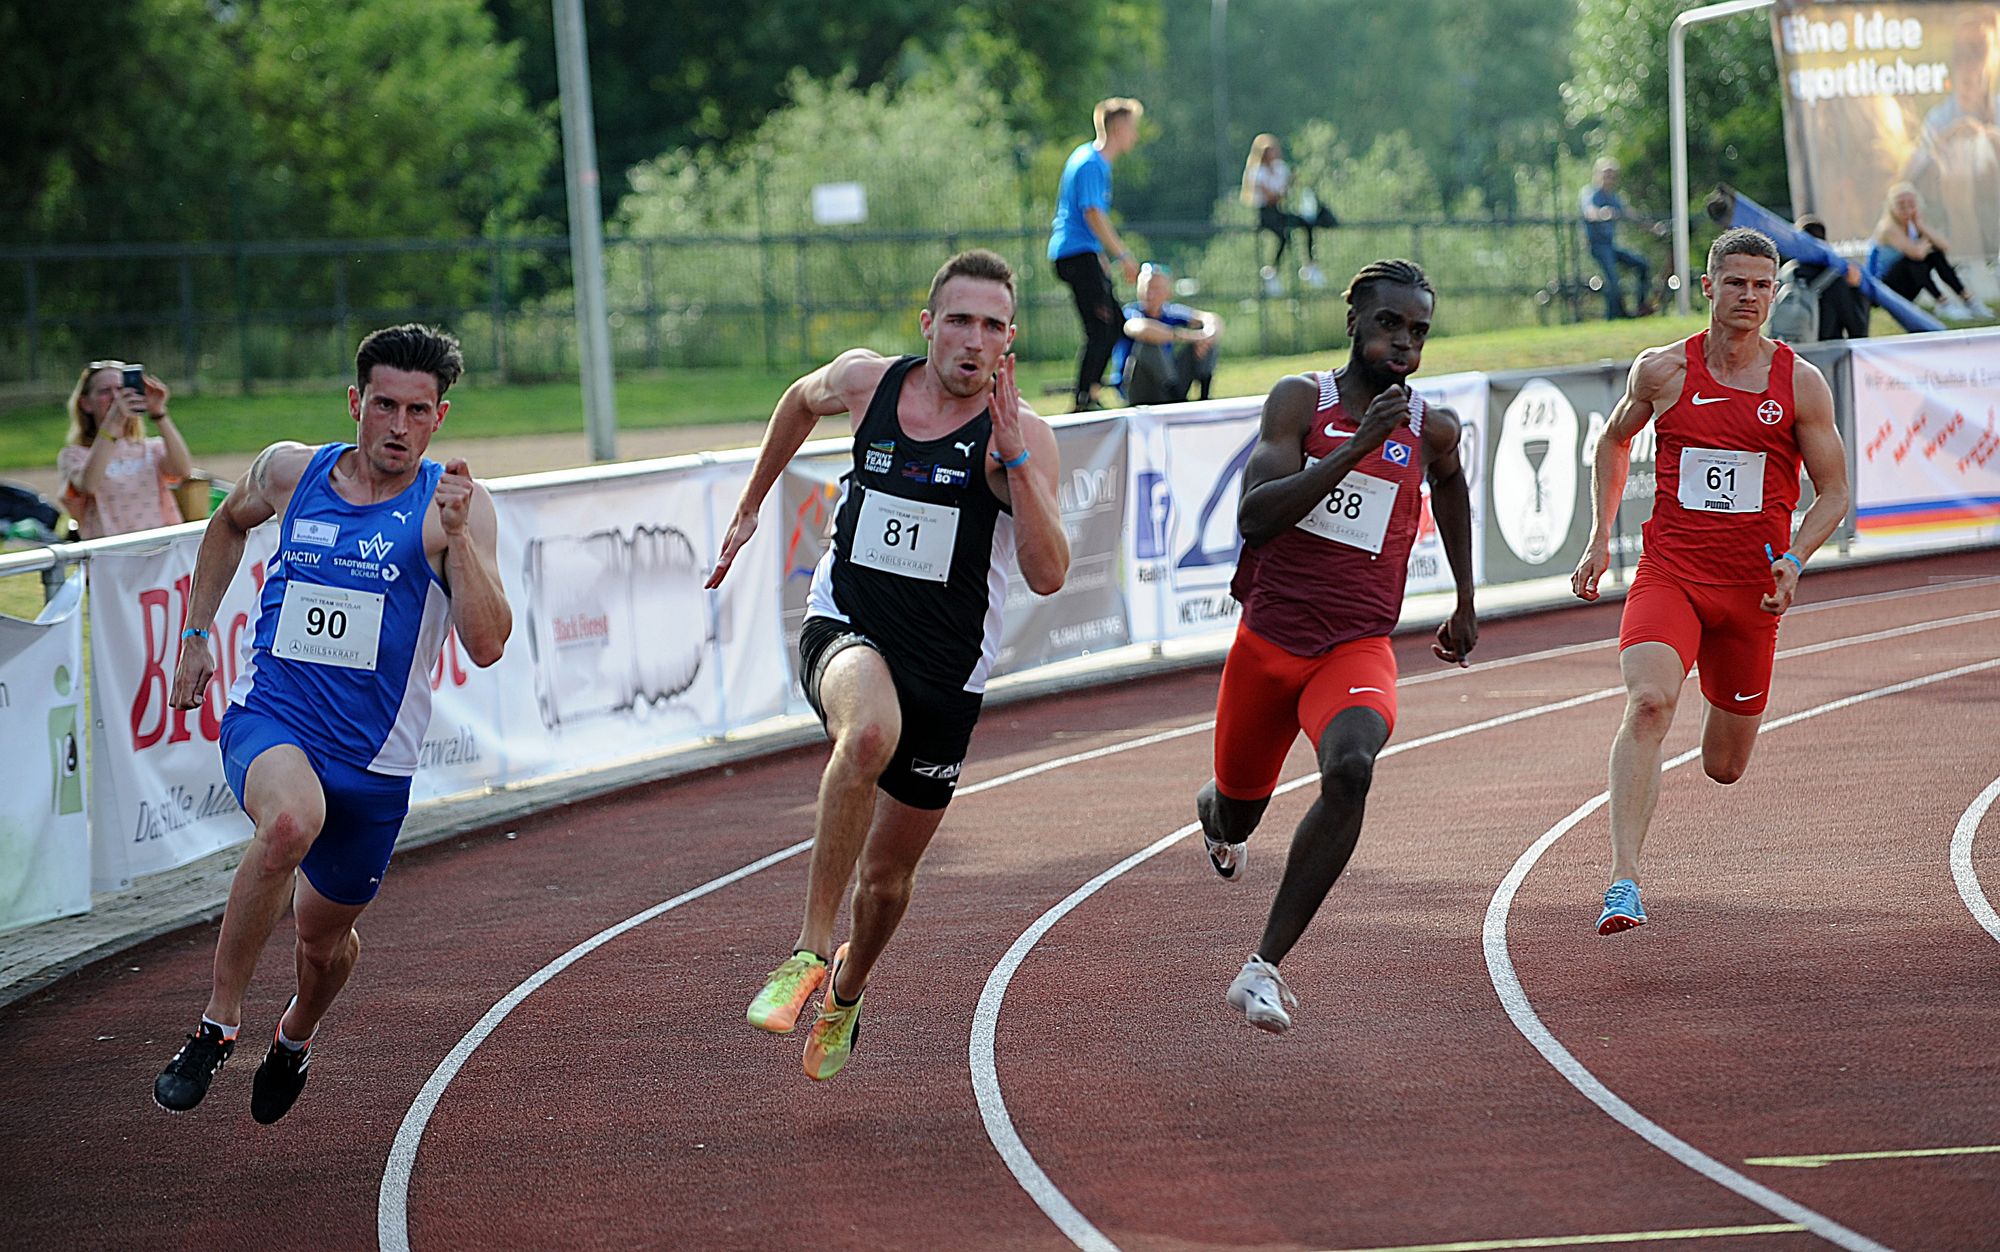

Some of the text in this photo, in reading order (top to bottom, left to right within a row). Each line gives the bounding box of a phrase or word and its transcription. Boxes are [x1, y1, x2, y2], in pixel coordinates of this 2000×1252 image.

[1854, 11, 1923, 50] Idee
[866, 449, 893, 461] SPRINT
[866, 456, 892, 469] TEAM
[864, 464, 889, 475] Wetzlar
[936, 467, 966, 478] SPEICHER
[1706, 466, 1736, 492] 61
[1325, 487, 1363, 520] 88
[1704, 499, 1731, 510] PUMA
[896, 511, 911, 519] TEAM
[882, 518, 921, 552] 81
[333, 557, 380, 572] STADTWERKE
[350, 567, 379, 580] BOCHUM
[318, 599, 334, 607] TEAM
[306, 606, 347, 640] 90
